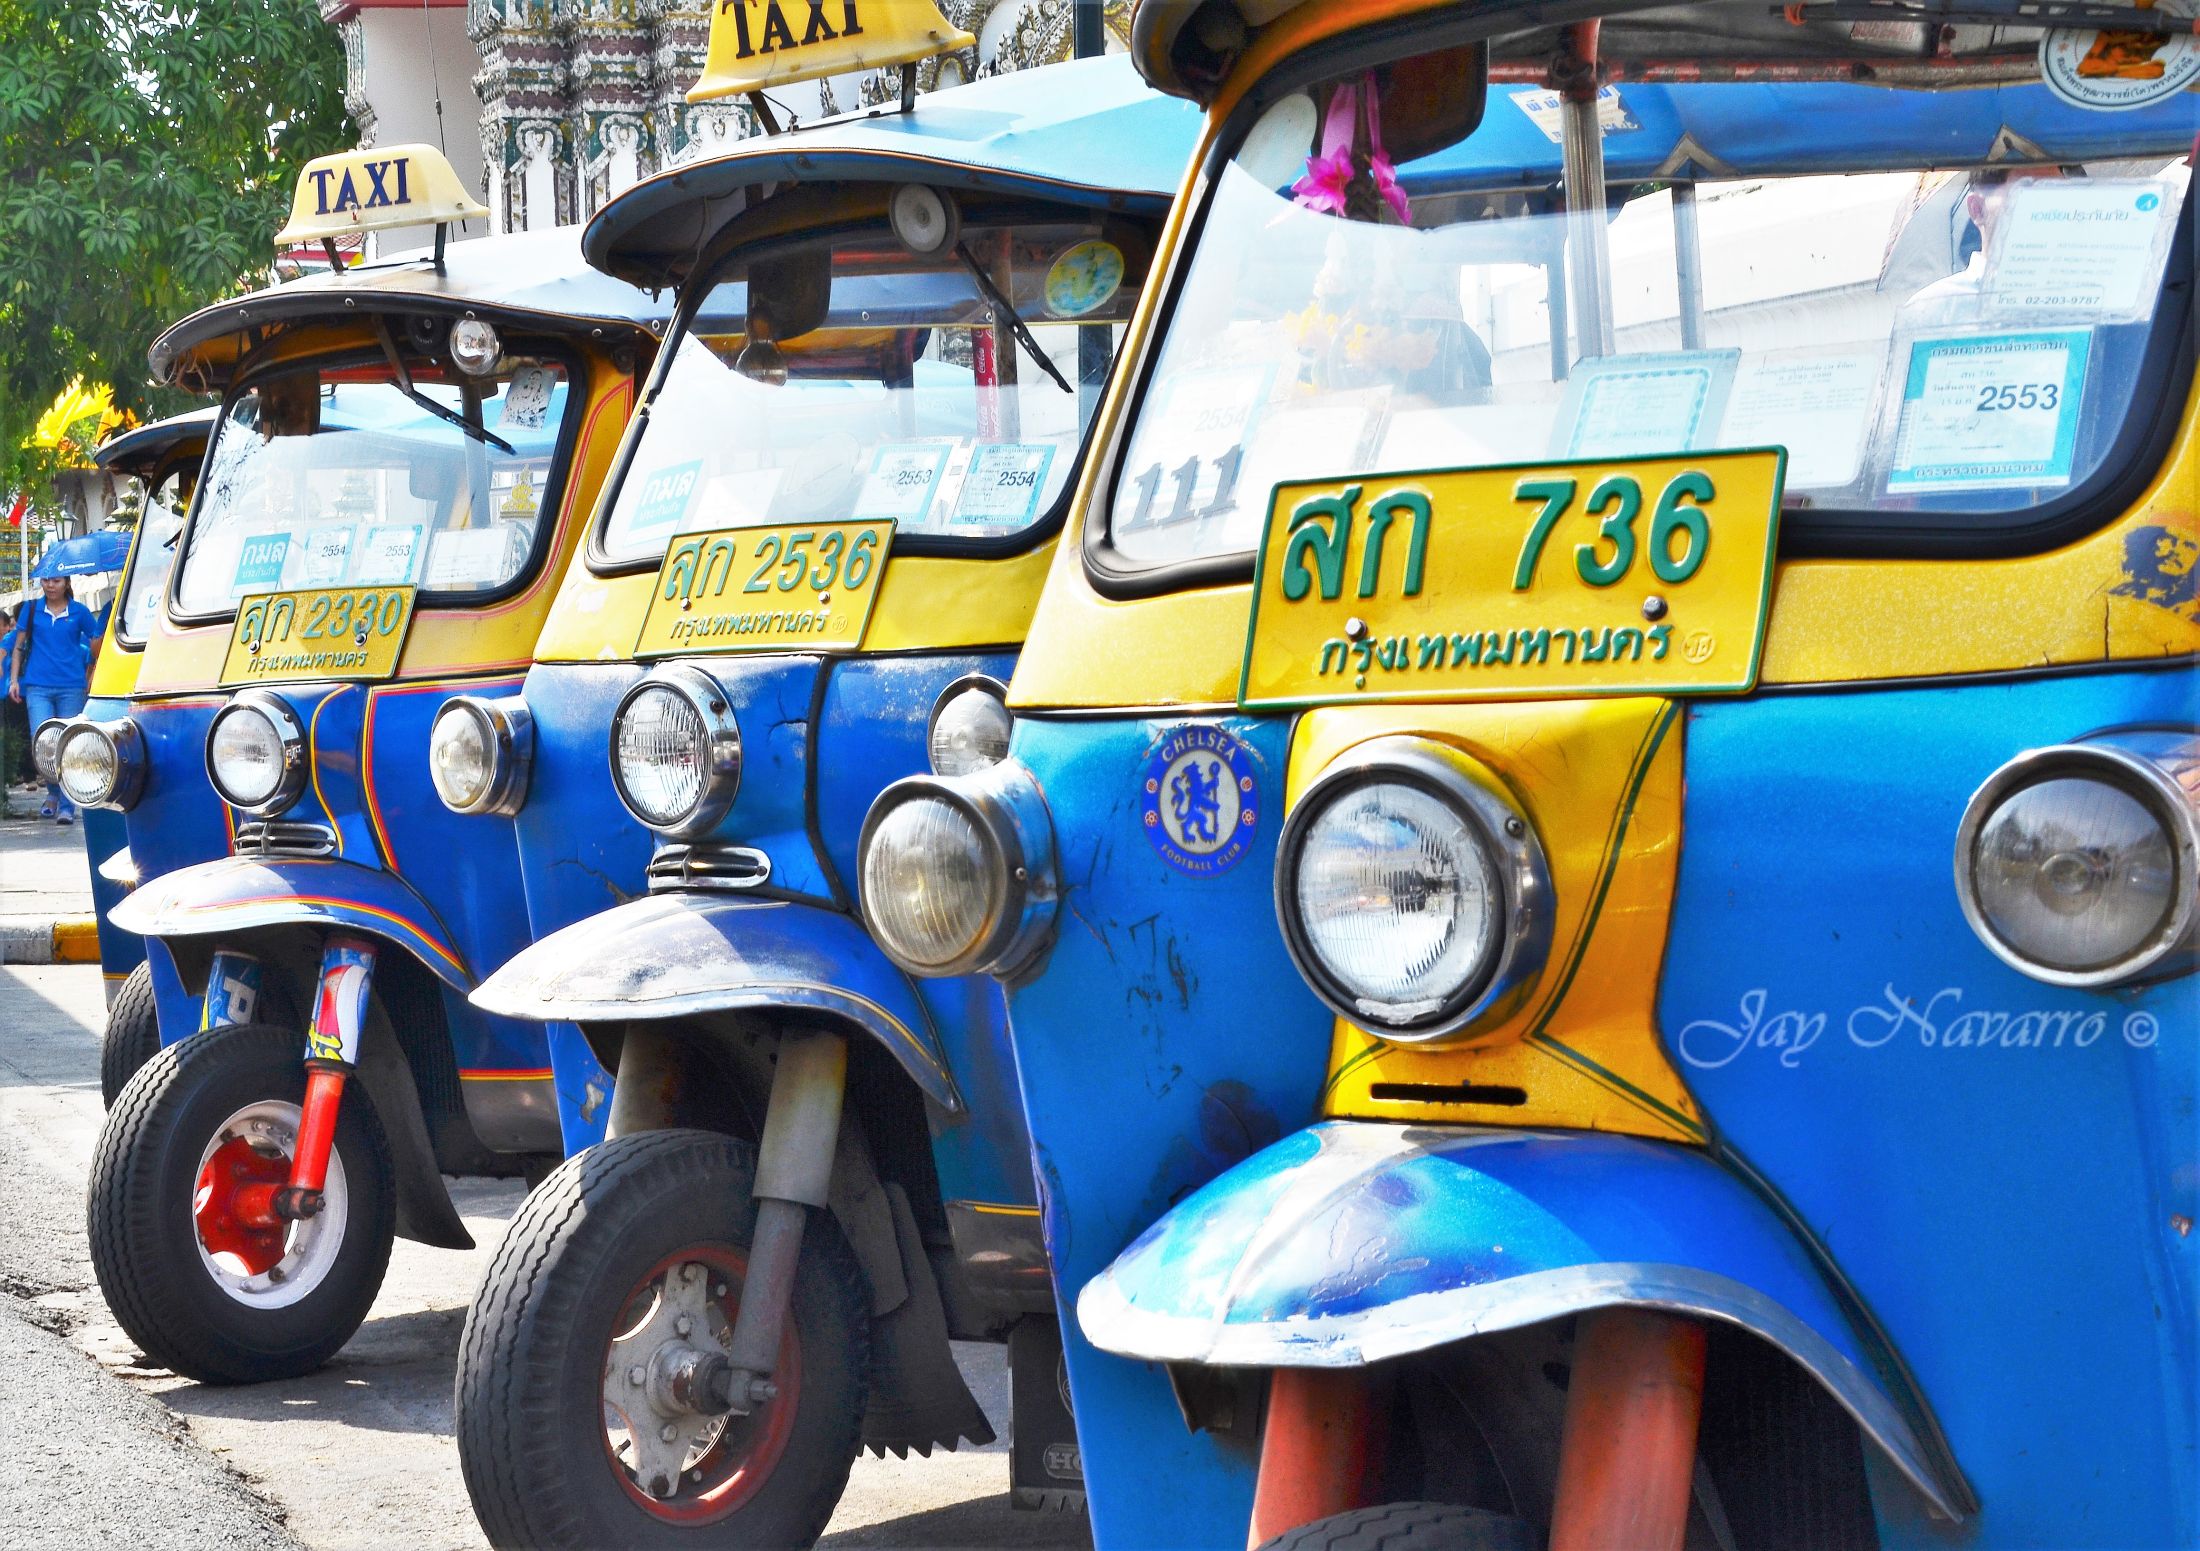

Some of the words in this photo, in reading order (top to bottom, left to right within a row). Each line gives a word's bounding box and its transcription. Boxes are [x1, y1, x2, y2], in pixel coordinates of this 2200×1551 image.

[721, 0, 863, 59] TAXI
[308, 158, 411, 216] TAXI
[2025, 295, 2101, 306] 02-203-9787
[1976, 383, 2059, 412] 2553
[896, 469, 933, 486] 2553
[997, 471, 1036, 487] 2554
[1118, 443, 1243, 533] 111
[321, 544, 347, 558] 2554
[385, 544, 410, 557] 2553
[1281, 484, 1432, 600] สก
[1513, 471, 1716, 590] 736
[665, 536, 736, 600] สก
[743, 529, 878, 593] 2536
[241, 596, 297, 643] สก
[303, 591, 403, 639] 2330
[671, 609, 832, 645] กรุงเทพมหานคร
[247, 650, 368, 678] กรุงเทพมหานคร
[1319, 624, 1675, 689] กรุงเทพมหานคร
[1162, 731, 1236, 763] CHELSEA
[1161, 843, 1212, 871] FOOTBALL
[1216, 842, 1240, 866] CLUB
